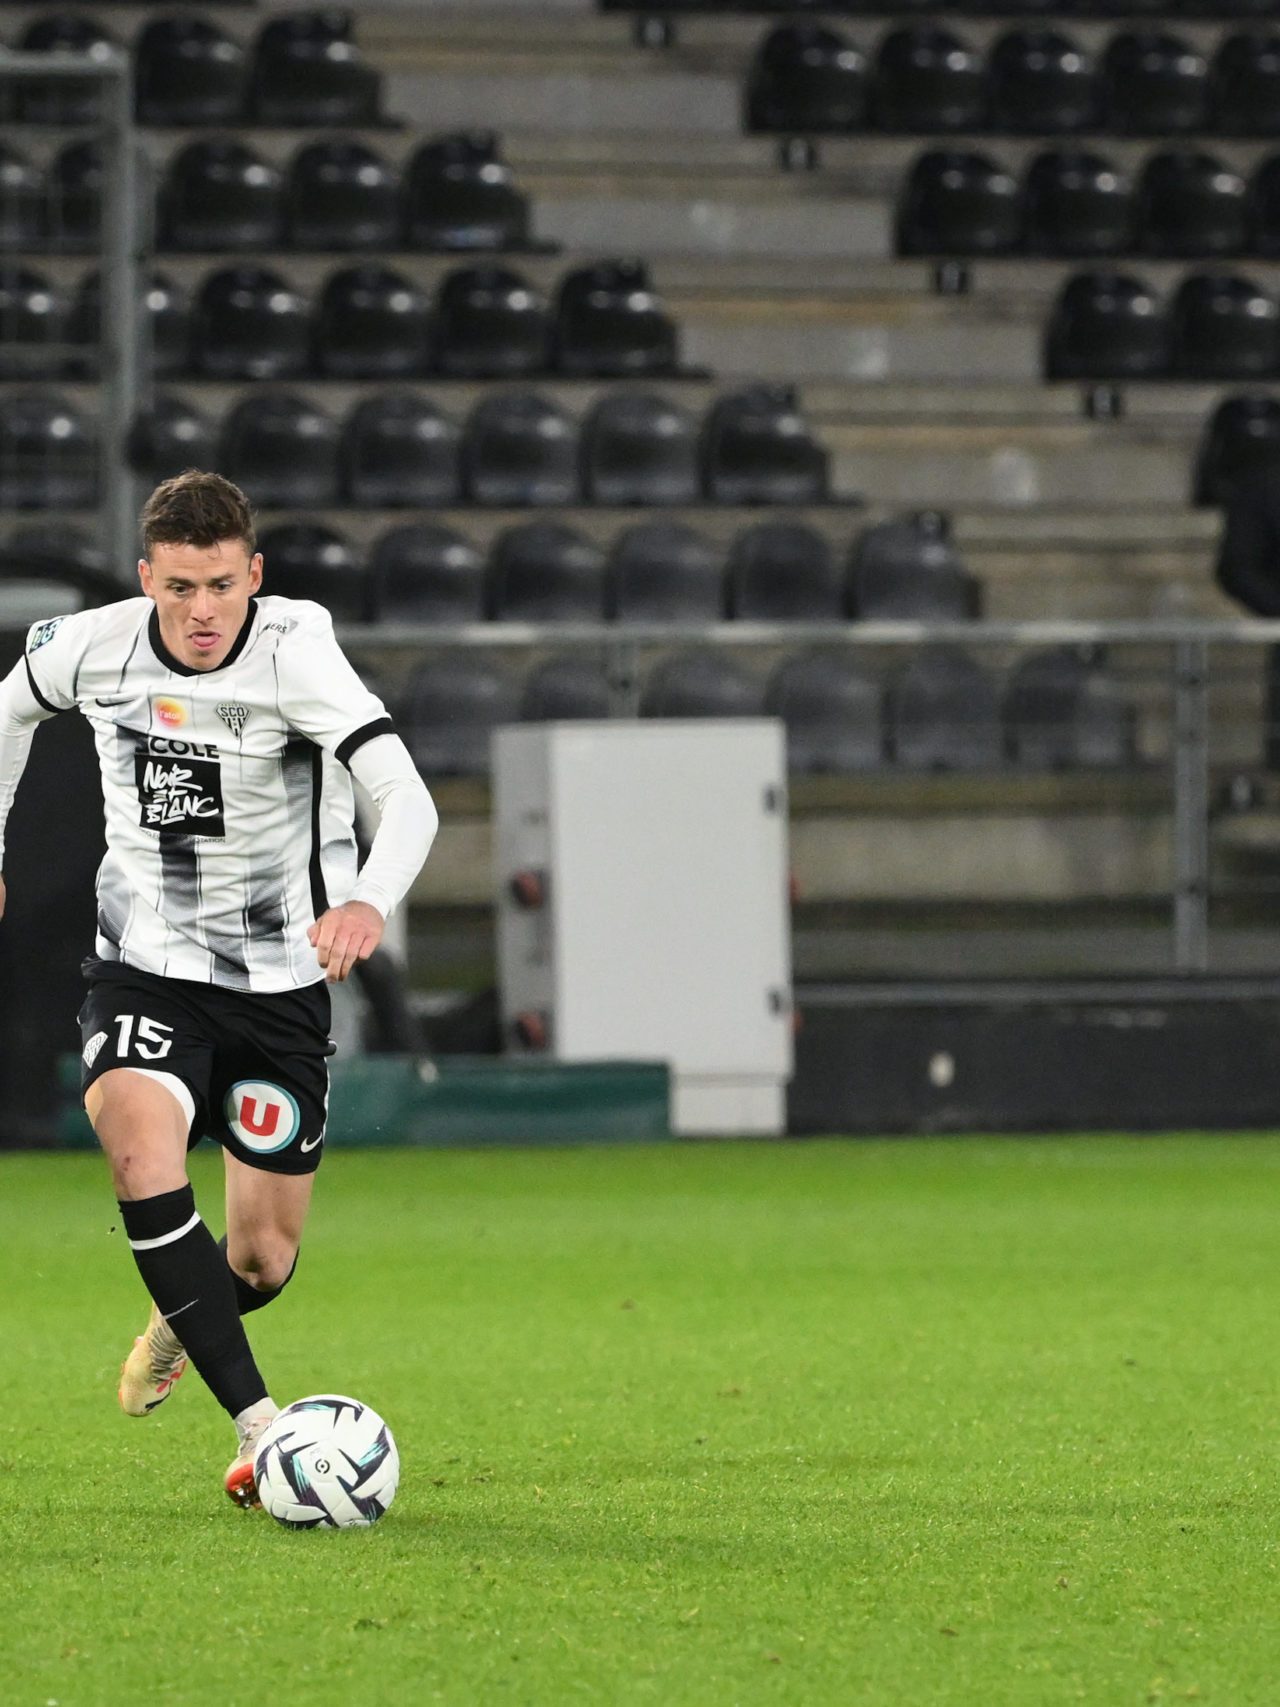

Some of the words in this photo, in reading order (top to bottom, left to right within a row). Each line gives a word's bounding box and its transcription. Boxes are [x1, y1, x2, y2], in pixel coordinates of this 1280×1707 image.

[220, 706, 245, 718] SCO
[147, 735, 220, 760] COLE
[114, 1014, 174, 1060] 15
[240, 1095, 280, 1136] U
